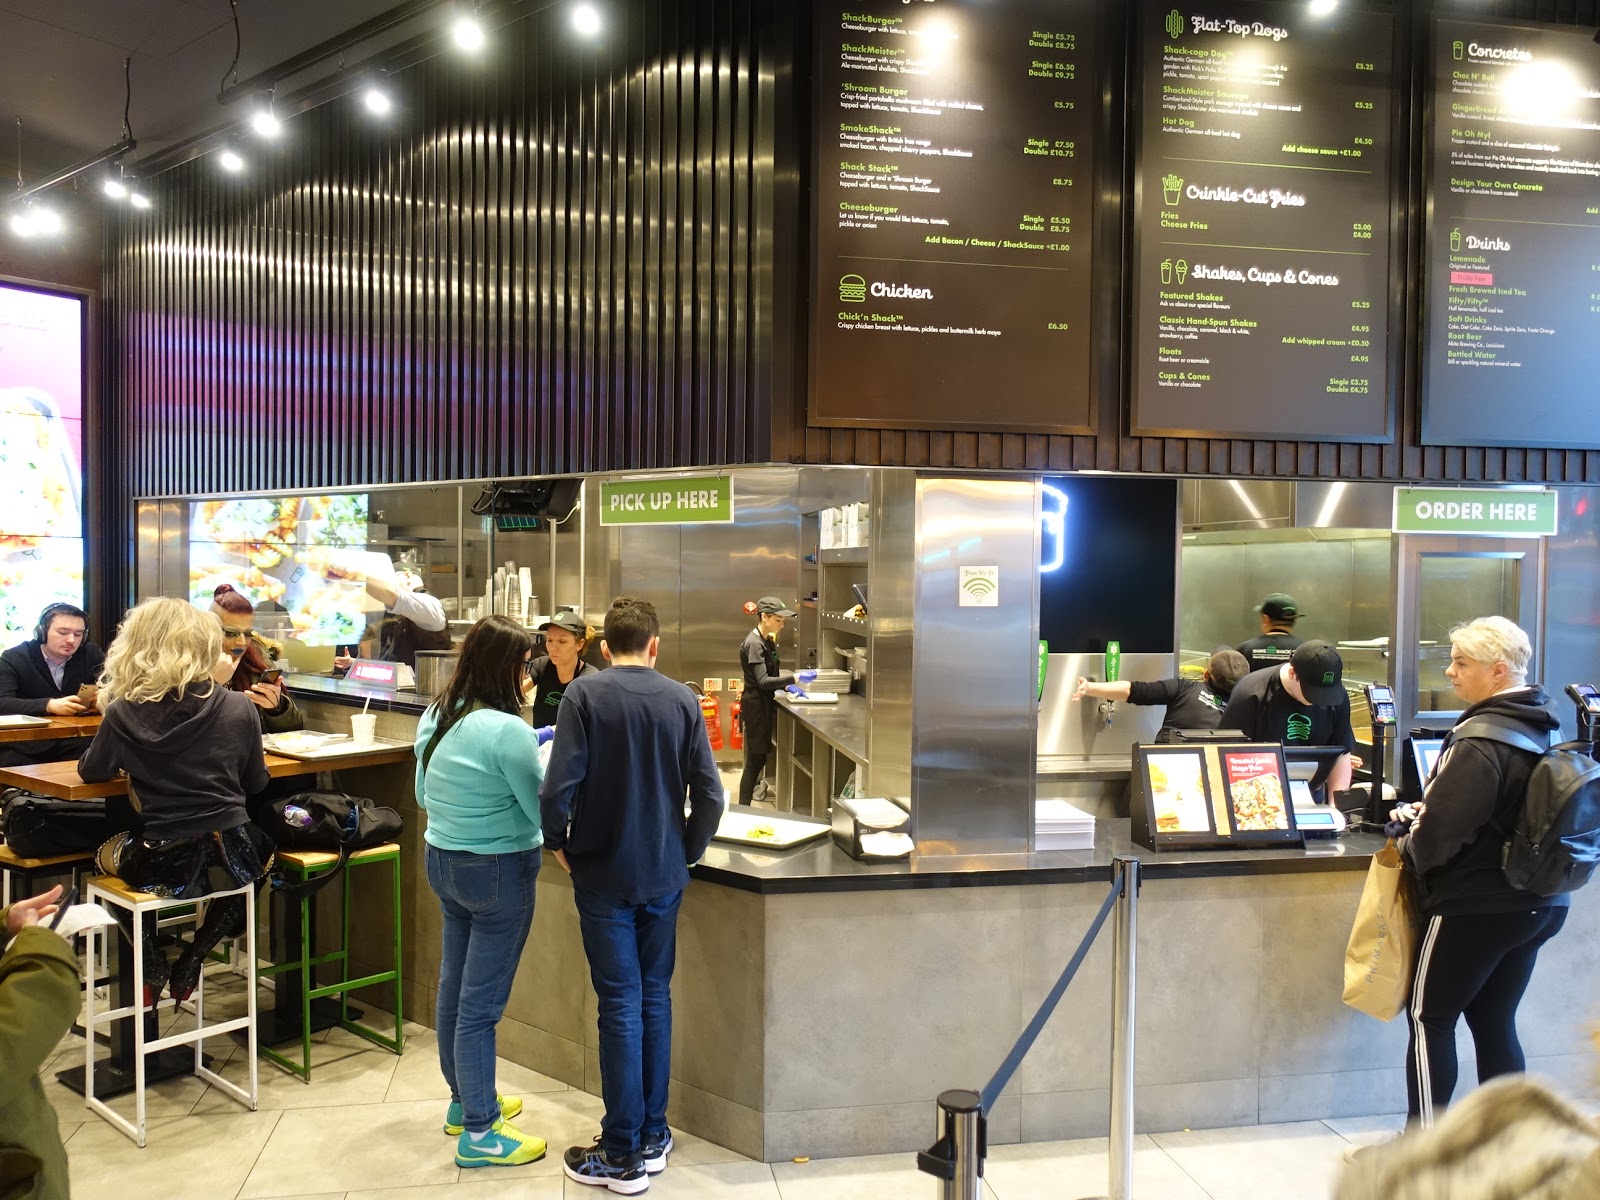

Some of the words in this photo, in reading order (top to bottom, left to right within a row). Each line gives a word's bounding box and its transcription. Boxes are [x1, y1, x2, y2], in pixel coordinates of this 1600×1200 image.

[1191, 16, 1250, 38] Flat-Top
[1252, 22, 1288, 41] Dogs
[1032, 31, 1054, 41] Single
[1056, 33, 1075, 41] £5.75
[1029, 40, 1054, 48] Double
[1055, 42, 1075, 50] £8.75
[1164, 46, 1209, 57] Shack-cago
[1468, 43, 1532, 60] Concretes
[1032, 61, 1054, 70] Single
[1056, 63, 1075, 71] £6.50
[1356, 63, 1374, 71] £5.25
[1028, 69, 1053, 78] Double
[1055, 71, 1074, 79] £9.75
[1453, 71, 1469, 79] Choc
[880, 86, 908, 96] Burger
[1163, 86, 1214, 96] ShackMeister
[1054, 102, 1074, 110] £5.75
[1355, 102, 1373, 110] £5.25
[1452, 103, 1496, 114] GingerBread
[1163, 117, 1176, 125] Hot
[1179, 118, 1195, 127] Dog
[1477, 131, 1491, 140] My!
[1027, 138, 1049, 148] Single
[1055, 140, 1074, 149] £7.50
[1024, 147, 1048, 157] Double
[1050, 149, 1074, 158] £10.75
[1297, 146, 1318, 154] cheese
[1320, 148, 1338, 156] sauce
[840, 162, 865, 171] Shack
[1053, 178, 1072, 186] £8.75
[1451, 178, 1474, 188] Design
[1476, 180, 1492, 188] Your
[1513, 183, 1542, 191] Concrete
[1186, 185, 1268, 204] Crinkle-Cut
[840, 202, 898, 214] Cheeseburger
[1023, 214, 1045, 224] Single
[1051, 216, 1070, 224] £5.50
[1161, 212, 1179, 220] Fries
[839, 220, 854, 229] pickle
[1020, 224, 1044, 232] Double
[1050, 225, 1070, 233] £8.75
[1161, 220, 1188, 228] Cheese
[1190, 222, 1208, 230] Fries
[1353, 231, 1371, 239] £4.00
[925, 236, 940, 244] Add
[942, 237, 964, 245] Bacon
[971, 239, 996, 247] Cheese
[1003, 240, 1044, 250] ShackSauce
[1046, 243, 1070, 251] +£1.00
[1466, 236, 1510, 251] Drinks
[1450, 255, 1485, 263] Lemonade
[1191, 264, 1246, 283] Shakes,
[1247, 267, 1282, 286] Cups
[1283, 270, 1297, 284] &
[1298, 270, 1339, 286] Cones
[870, 282, 933, 300] Chicken
[1470, 286, 1496, 294] Brewed
[1160, 292, 1194, 300] Featured
[1196, 293, 1223, 302] Shakes
[1159, 316, 1184, 324] Classic
[1187, 317, 1228, 327] Hand-Spun
[1230, 319, 1257, 327] Shakes
[1464, 316, 1487, 324] Drinks
[1048, 322, 1068, 330] £6.50
[1297, 337, 1325, 346] whipped
[1159, 347, 1181, 355] Floats
[1159, 372, 1177, 380] Cups
[1187, 373, 1210, 381] Cones
[1350, 386, 1368, 394] £4.75
[611, 493, 645, 511] PICK
[650, 492, 672, 510] UP
[677, 490, 718, 509] HERE
[1416, 501, 1483, 520] ORDER
[1490, 503, 1536, 521] HERE
